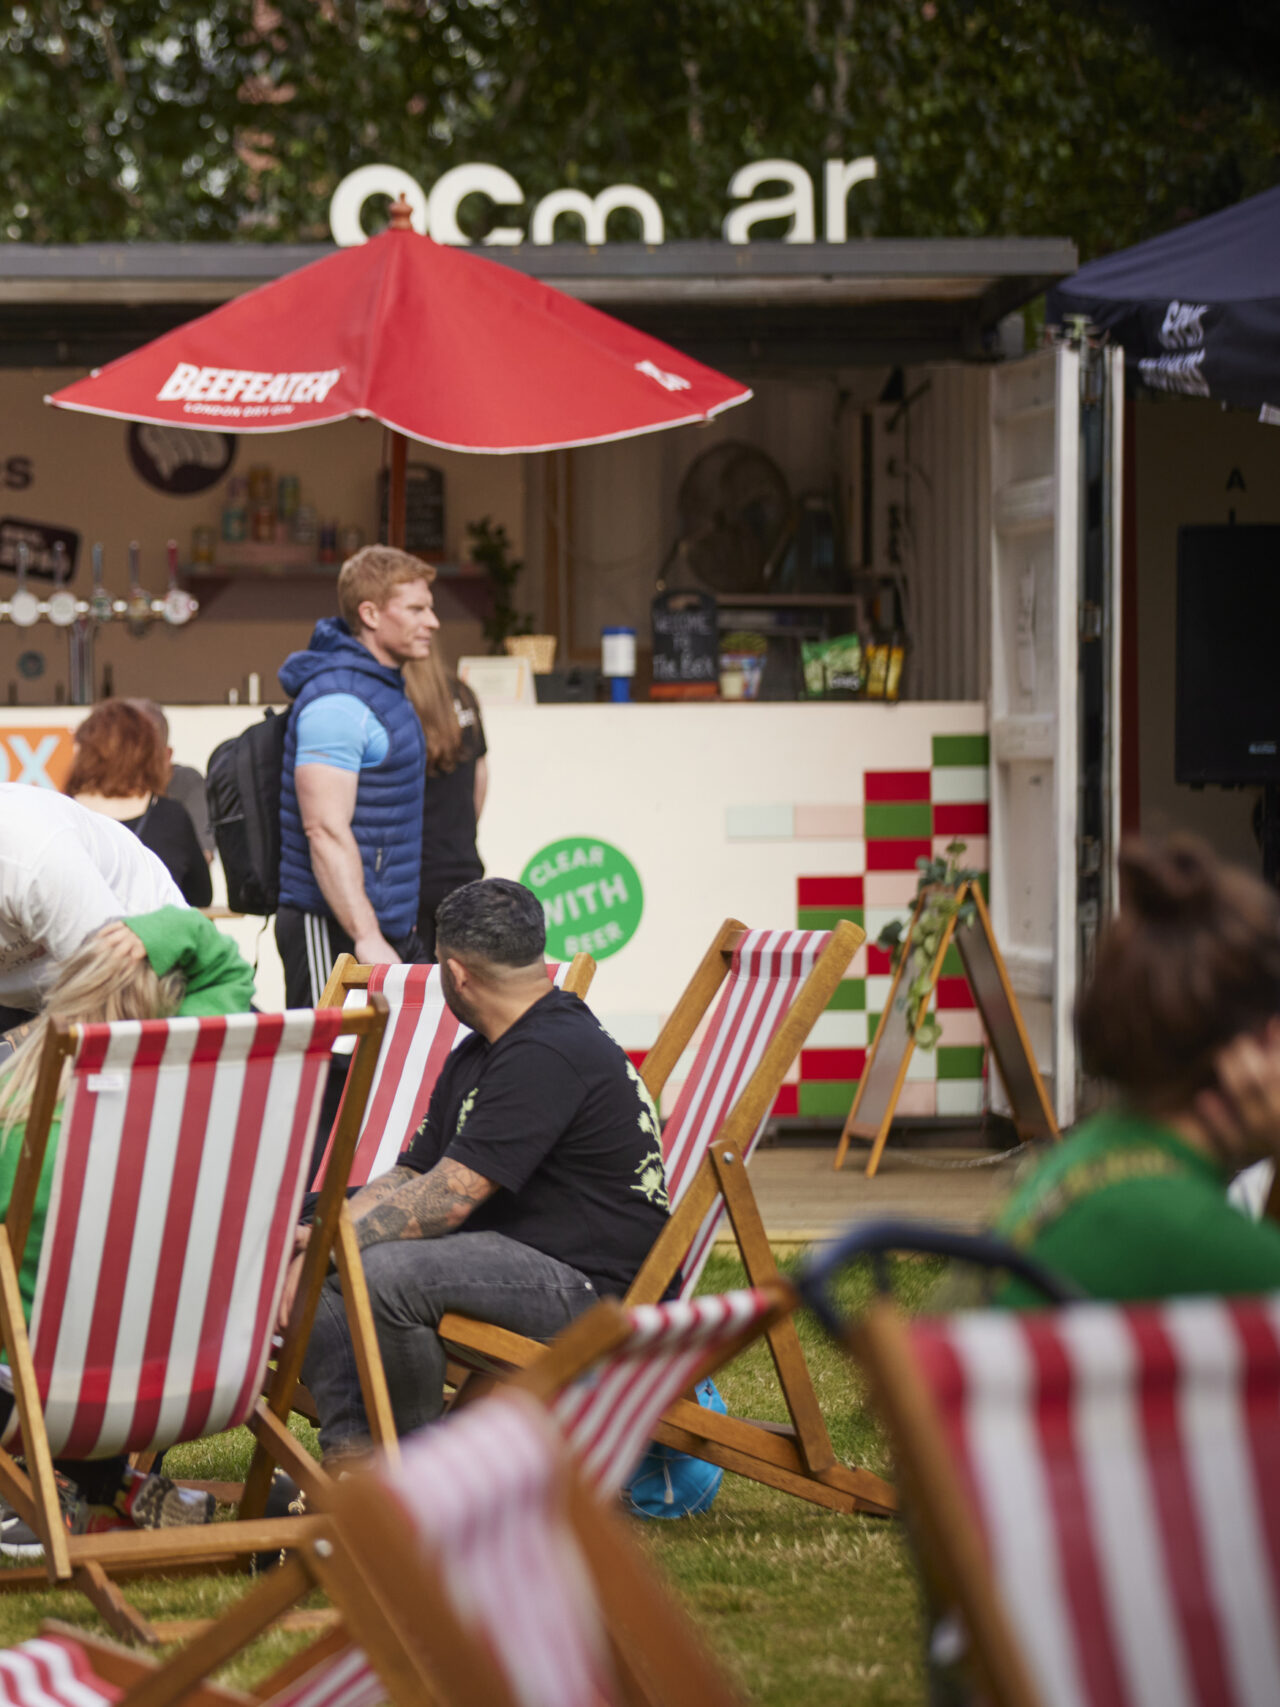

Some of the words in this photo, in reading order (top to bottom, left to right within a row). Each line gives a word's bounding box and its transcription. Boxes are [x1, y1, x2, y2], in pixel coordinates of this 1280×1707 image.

[157, 362, 341, 404] BEEFEATER
[184, 402, 240, 418] LONDON
[564, 921, 624, 957] BEER
